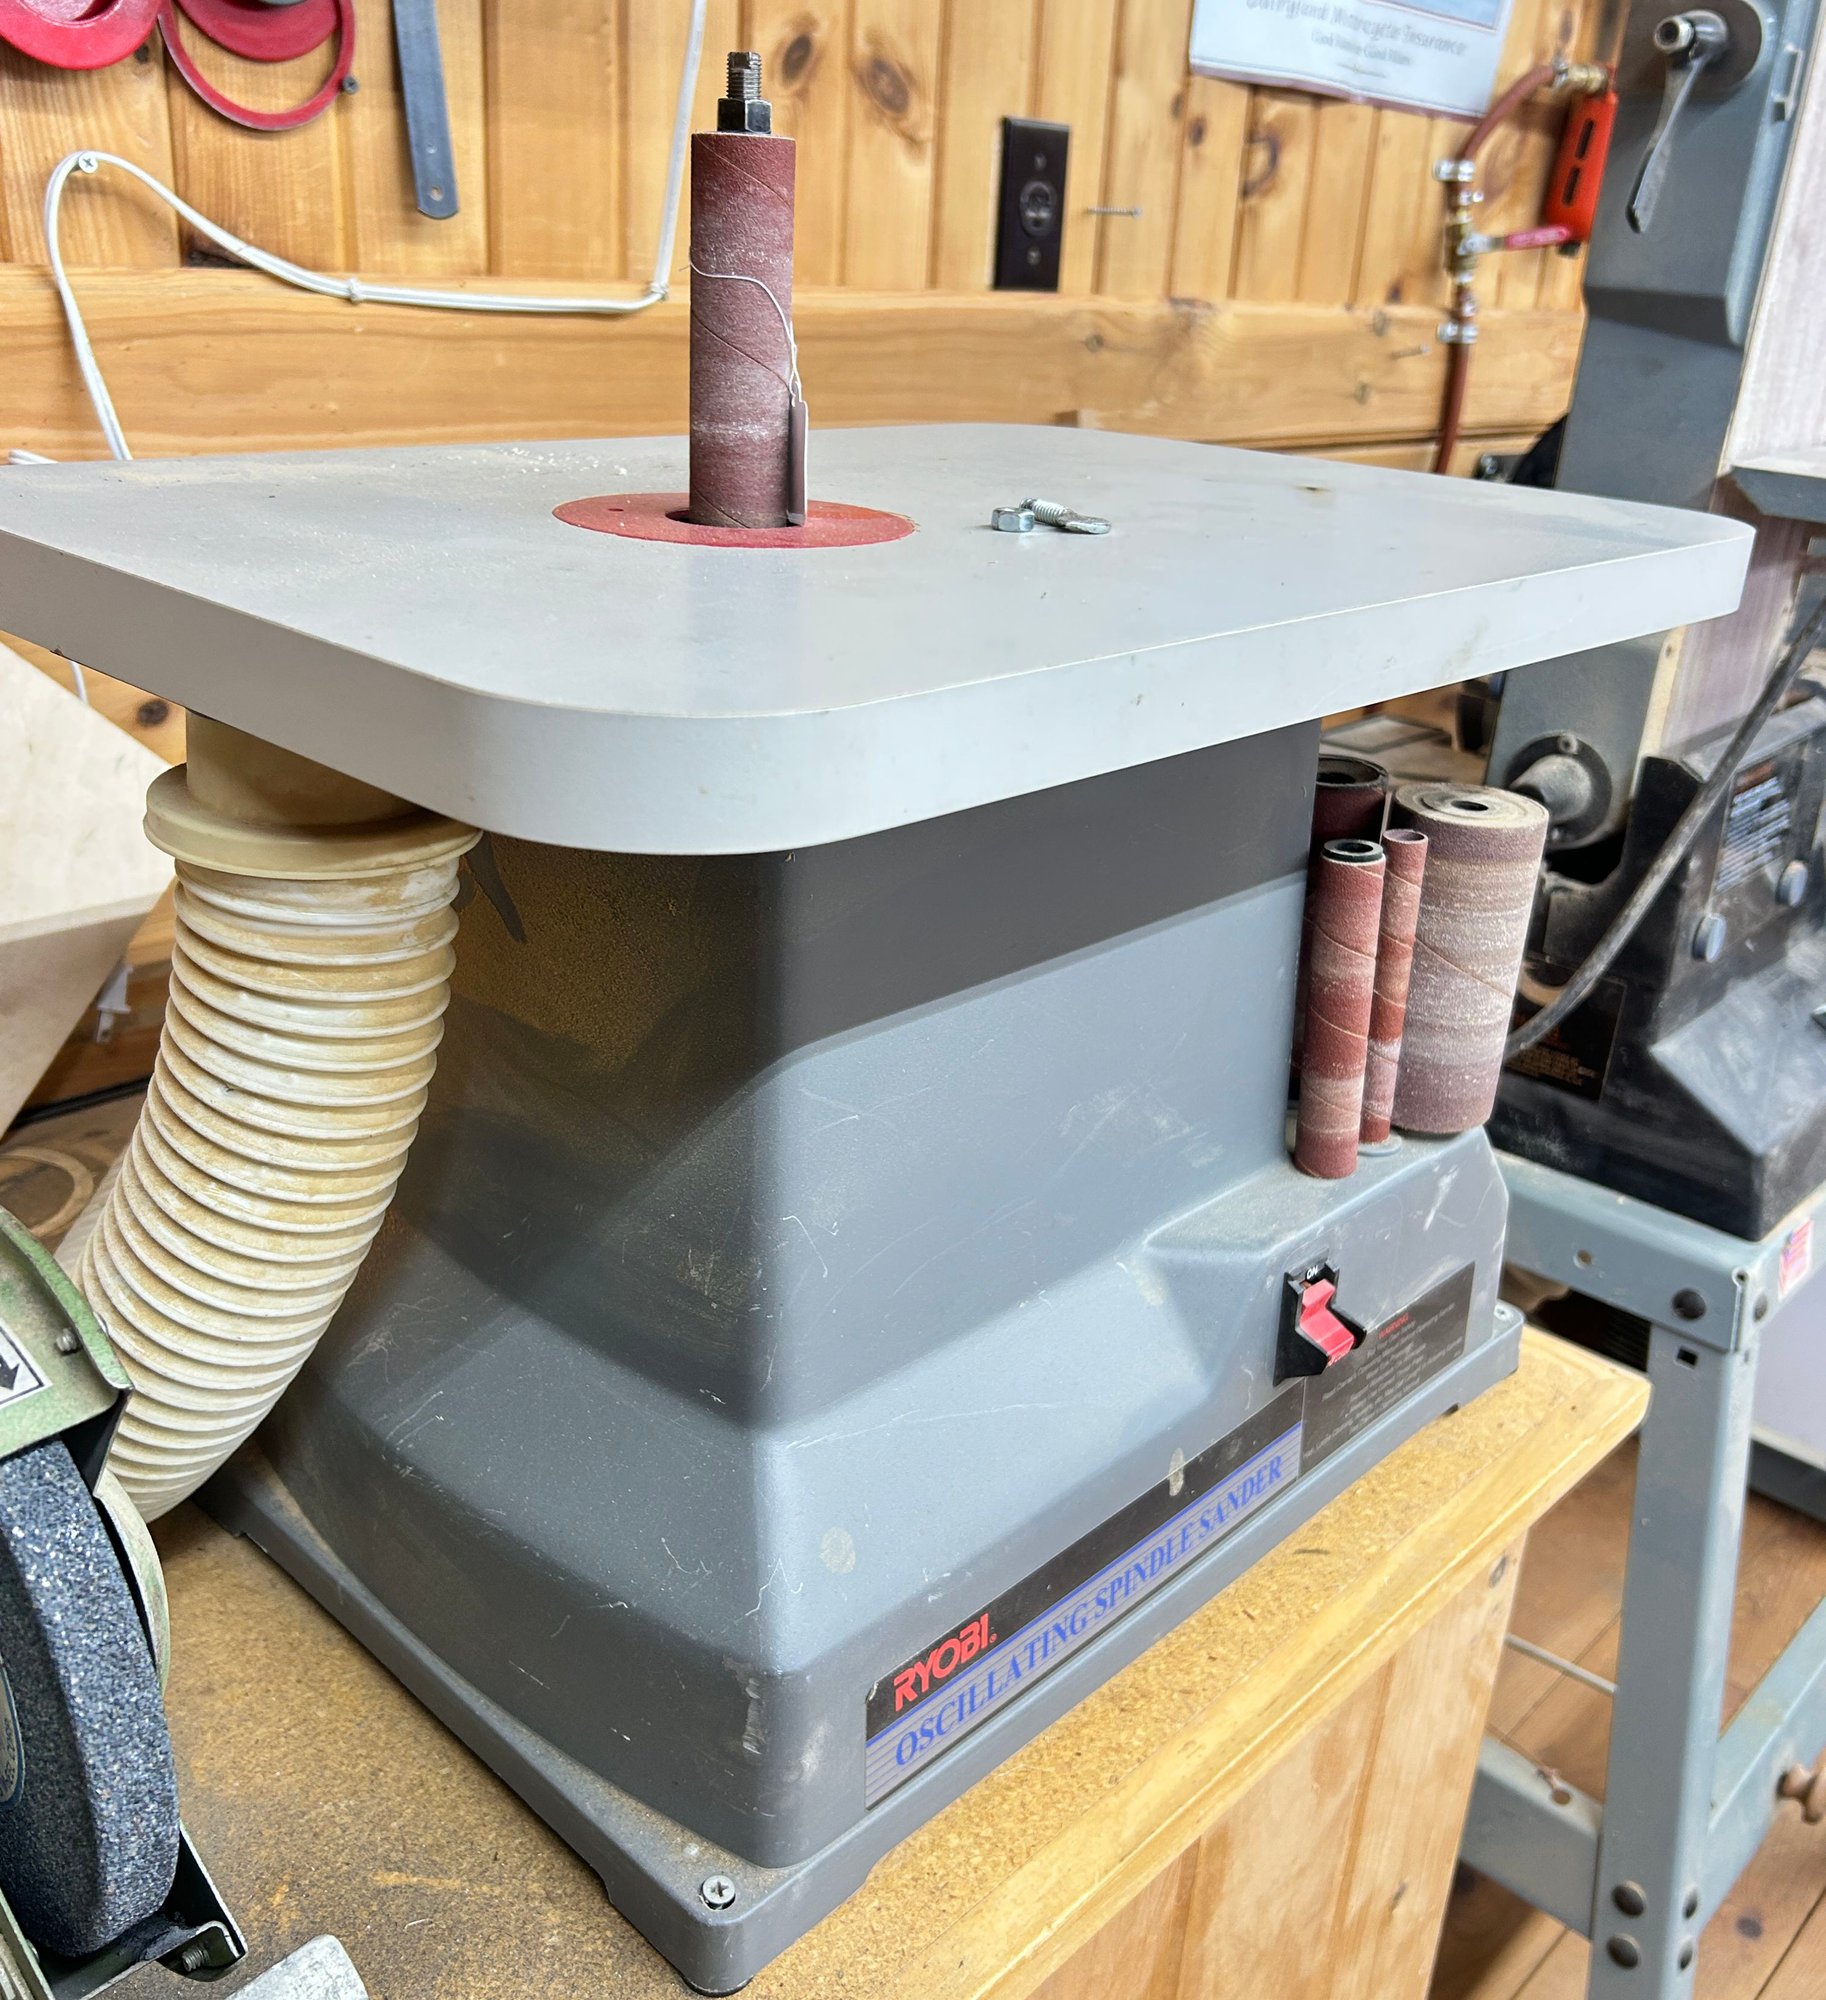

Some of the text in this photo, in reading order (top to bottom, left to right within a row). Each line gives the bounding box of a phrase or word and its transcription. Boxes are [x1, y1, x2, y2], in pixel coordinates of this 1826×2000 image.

[1403, 24, 1468, 56] Insurance
[1306, 1264, 1319, 1280] ON
[896, 1455, 1282, 1766] OSCILLATING SPINDLE SANDER
[893, 1612, 989, 1712] RYOBI
